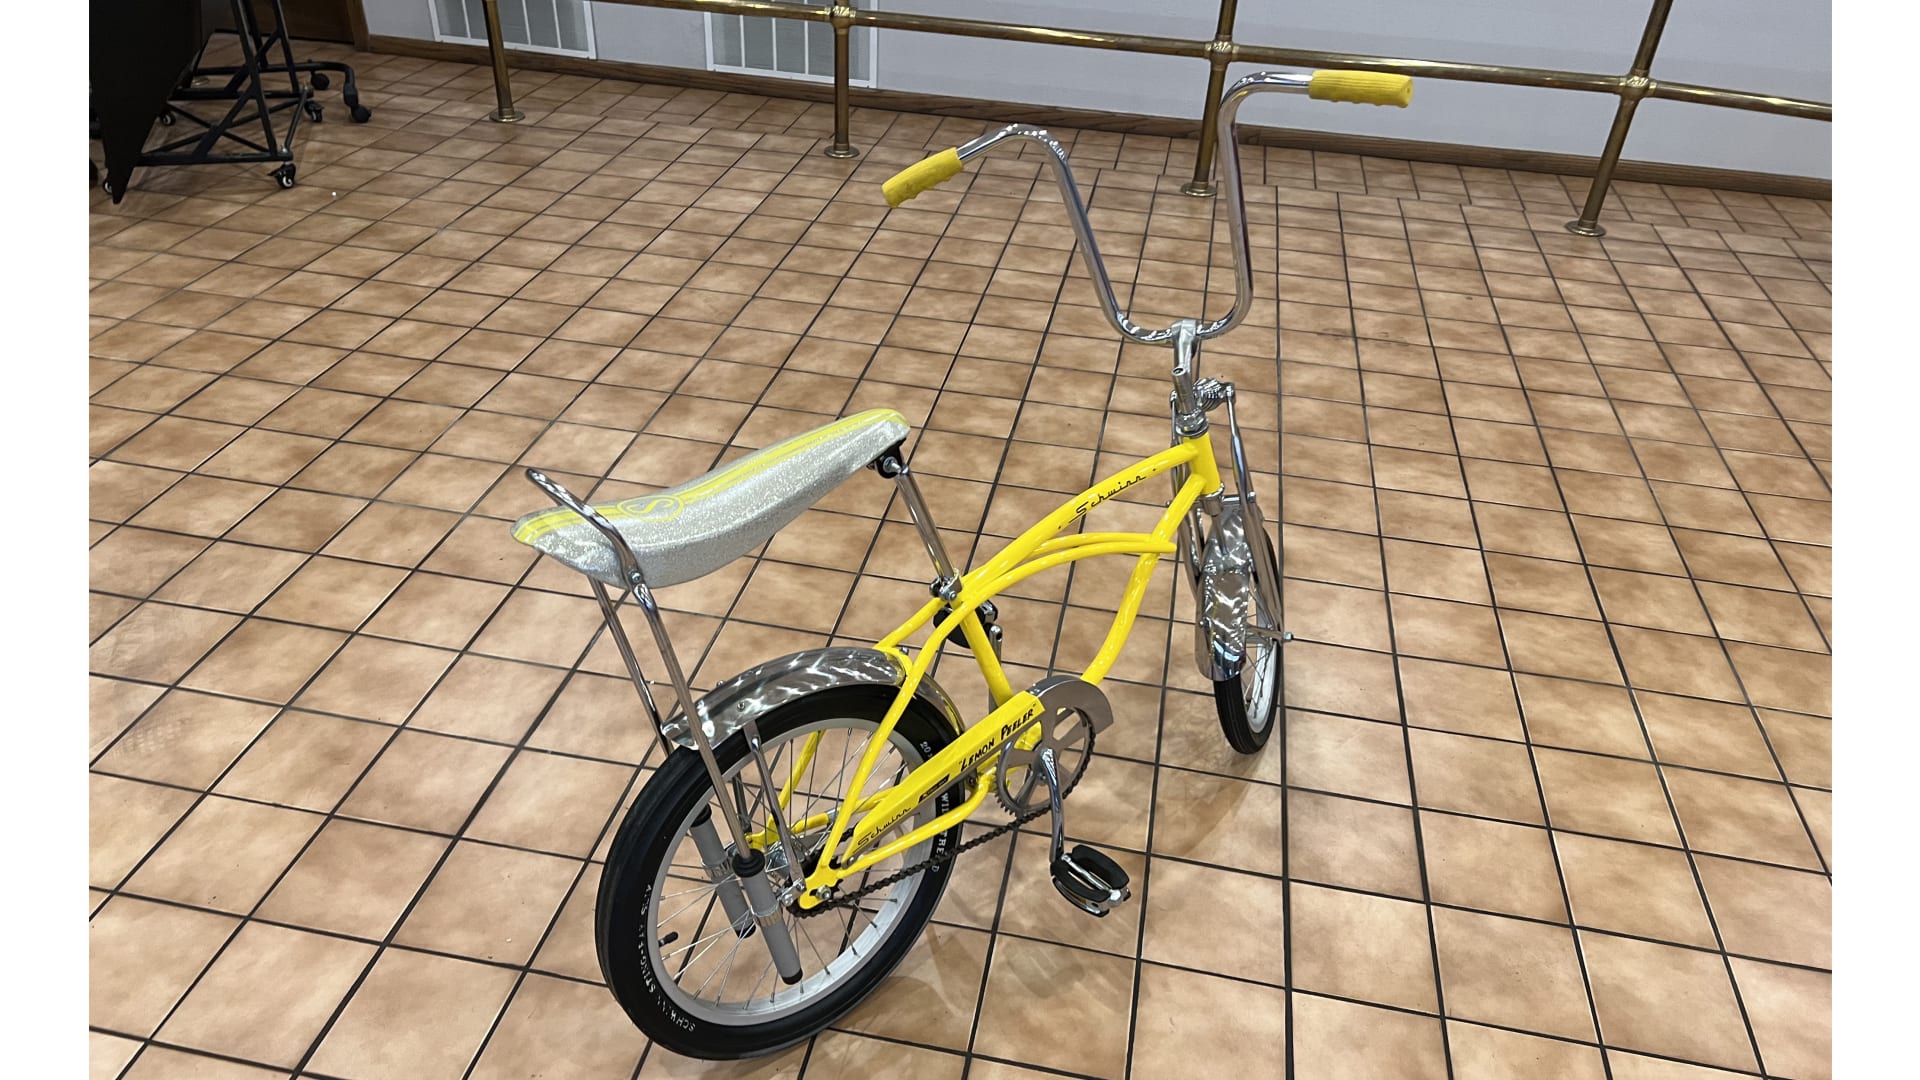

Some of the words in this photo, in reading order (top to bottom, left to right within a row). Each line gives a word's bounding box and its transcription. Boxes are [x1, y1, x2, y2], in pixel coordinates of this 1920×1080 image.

[1068, 475, 1147, 524] Schwinn
[852, 807, 912, 854] Schwinn
[931, 830, 949, 872] TRED
